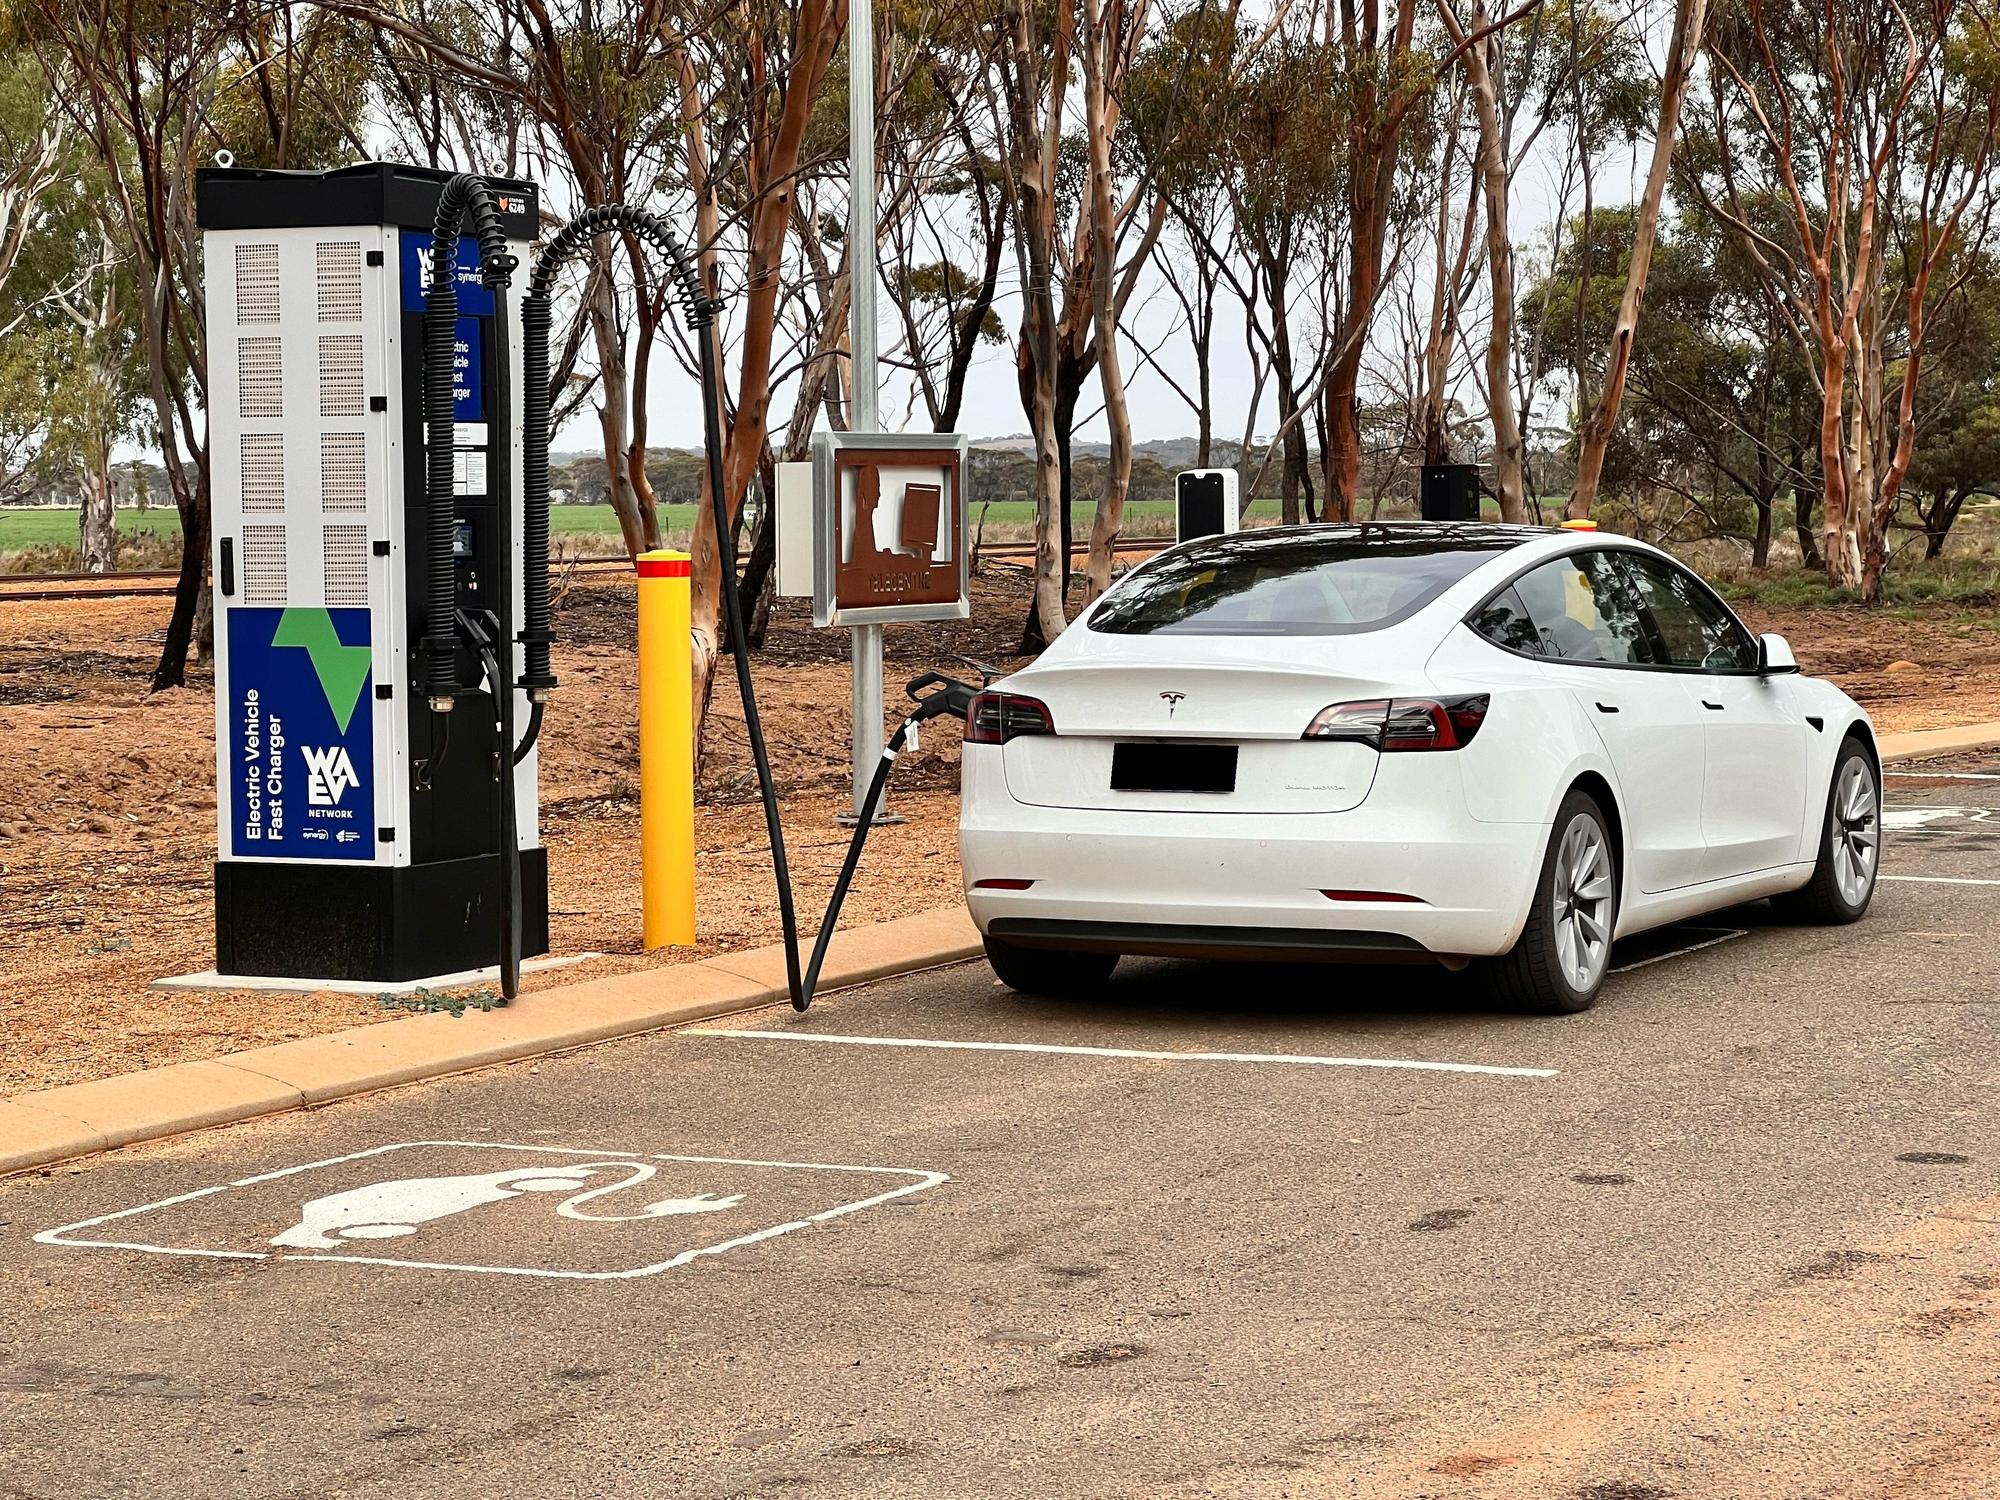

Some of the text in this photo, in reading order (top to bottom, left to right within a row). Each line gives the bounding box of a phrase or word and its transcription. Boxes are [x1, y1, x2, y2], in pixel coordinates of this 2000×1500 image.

[508, 203, 525, 214] 6249
[458, 272, 483, 285] synerg
[244, 688, 261, 839] Electric Vehicle
[267, 714, 285, 840] Fast Charger
[308, 809, 353, 818] NETWORK
